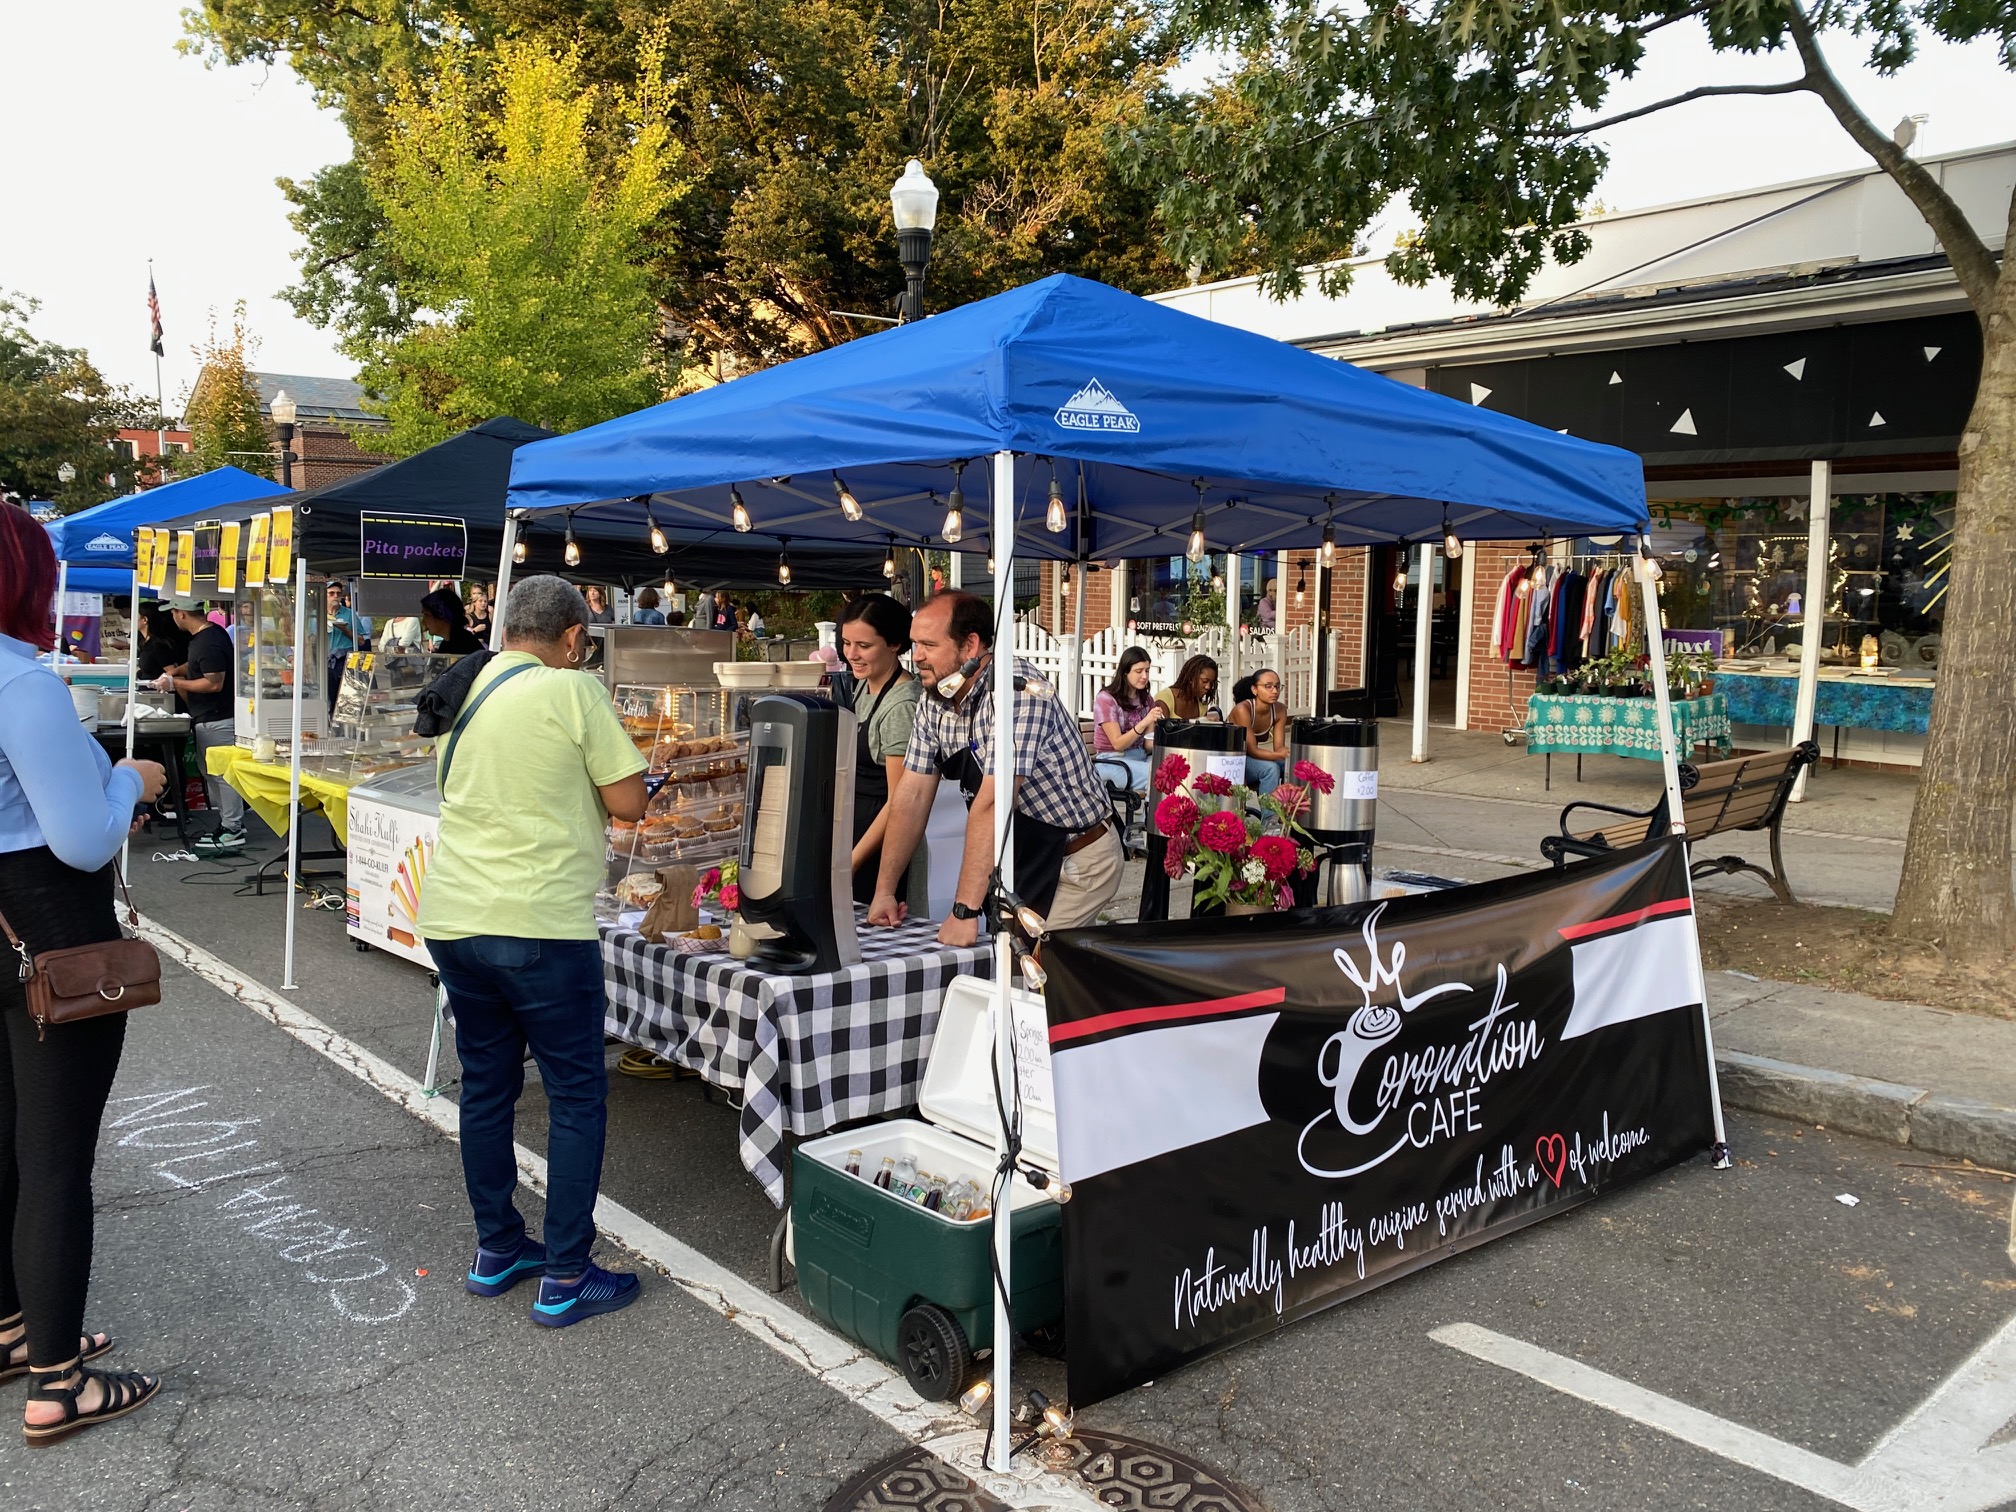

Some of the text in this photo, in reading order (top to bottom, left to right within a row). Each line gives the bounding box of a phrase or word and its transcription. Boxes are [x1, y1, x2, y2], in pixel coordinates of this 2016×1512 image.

[1060, 412, 1136, 430] EAGLE PEAK
[364, 539, 465, 560] Pita pockets
[1136, 621, 1152, 631] SOFT
[1249, 626, 1276, 636] SALADS
[348, 805, 401, 852] Shahi Kulfi
[1020, 1019, 1043, 1046] Springs
[1318, 962, 1545, 1135] Coronation
[1408, 1076, 1483, 1149] CAFÉ
[1174, 1110, 1651, 1330] Naturally healthy cuisine served with a of welcome.
